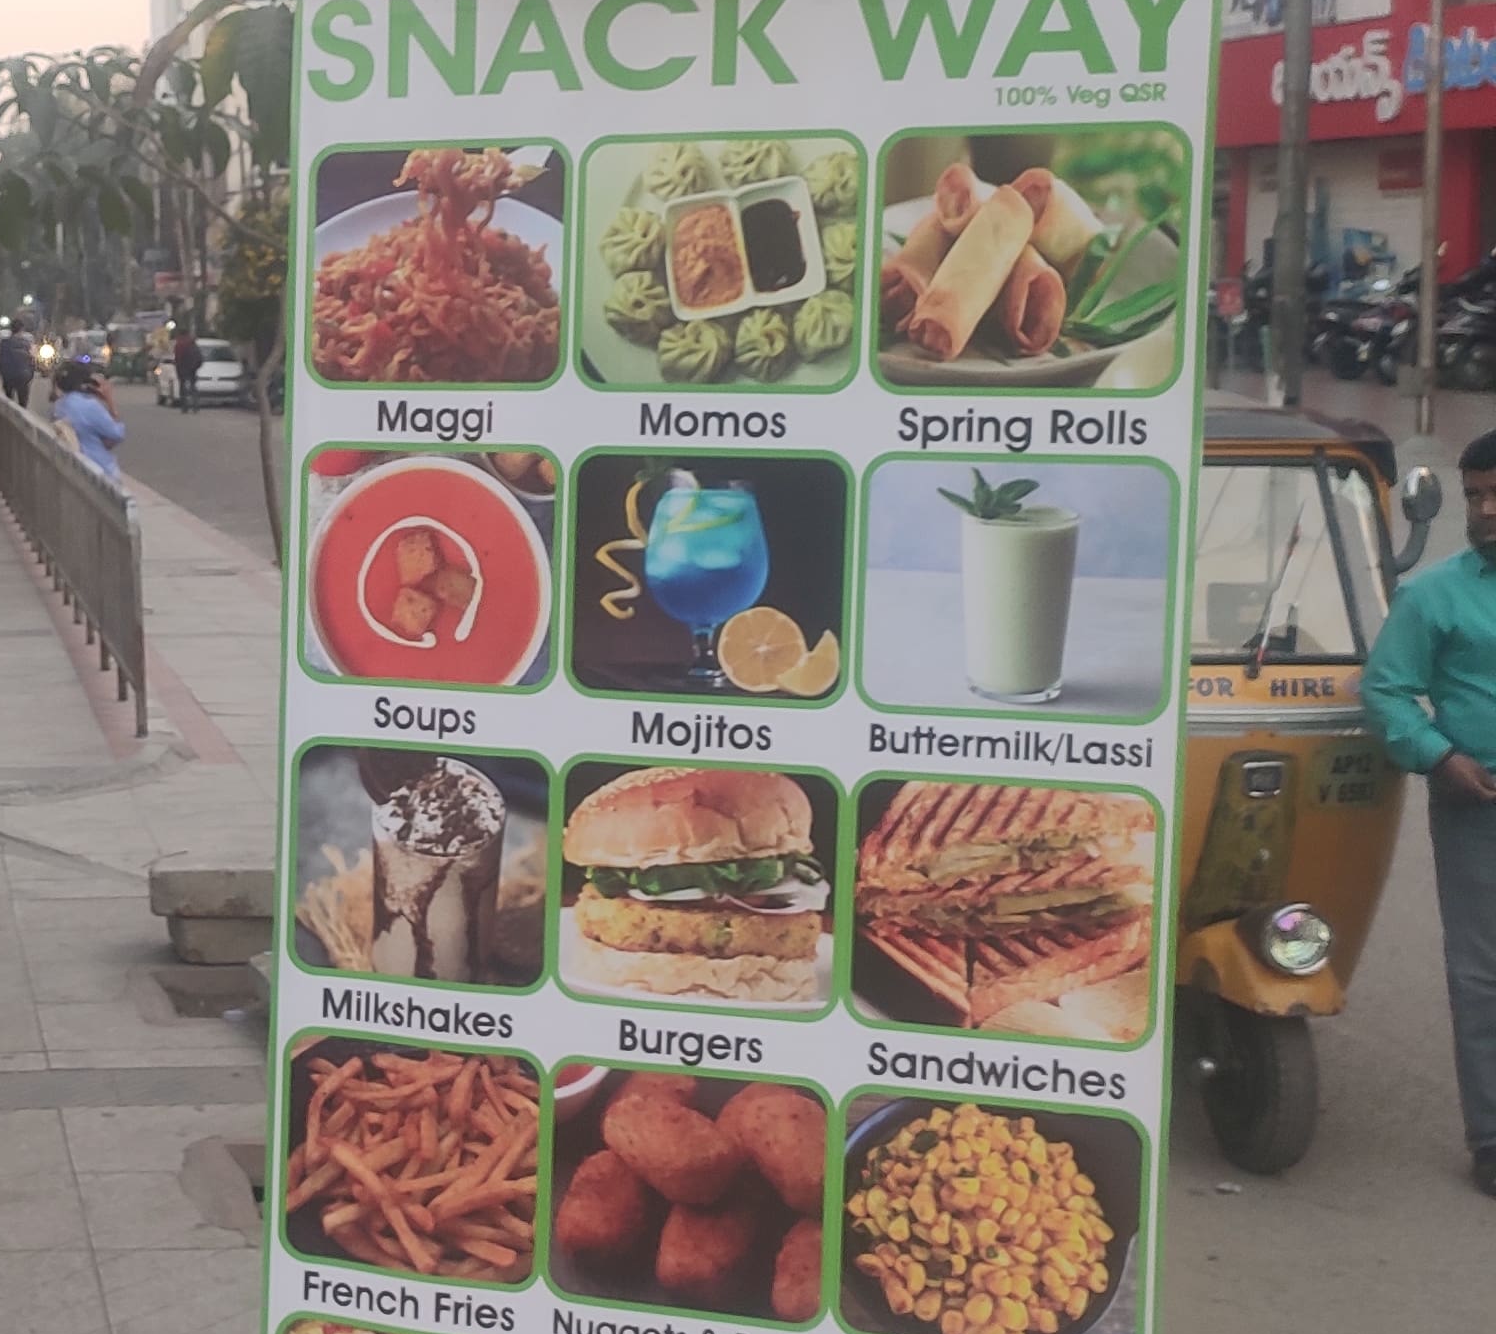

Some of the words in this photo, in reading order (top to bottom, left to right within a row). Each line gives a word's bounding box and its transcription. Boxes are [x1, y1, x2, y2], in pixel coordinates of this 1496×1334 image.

[994, 85, 1058, 107] 100%
[1066, 84, 1111, 109] Veg
[1118, 82, 1168, 103] QSR
[376, 400, 494, 441] Maggi
[639, 402, 787, 439] Momos
[897, 406, 1033, 454] Spring
[1049, 409, 1149, 446] Rolls
[1270, 676, 1336, 698] HIRE
[373, 695, 477, 739] Soups
[630, 710, 773, 754] Mojitos
[868, 722, 1153, 769] Buttermilk/Lassi
[321, 987, 514, 1040] Milkshakes
[618, 1018, 764, 1067] Burgers
[866, 1041, 1127, 1100] Sandwiches
[304, 1270, 419, 1320] French
[434, 1291, 515, 1332] Fries
